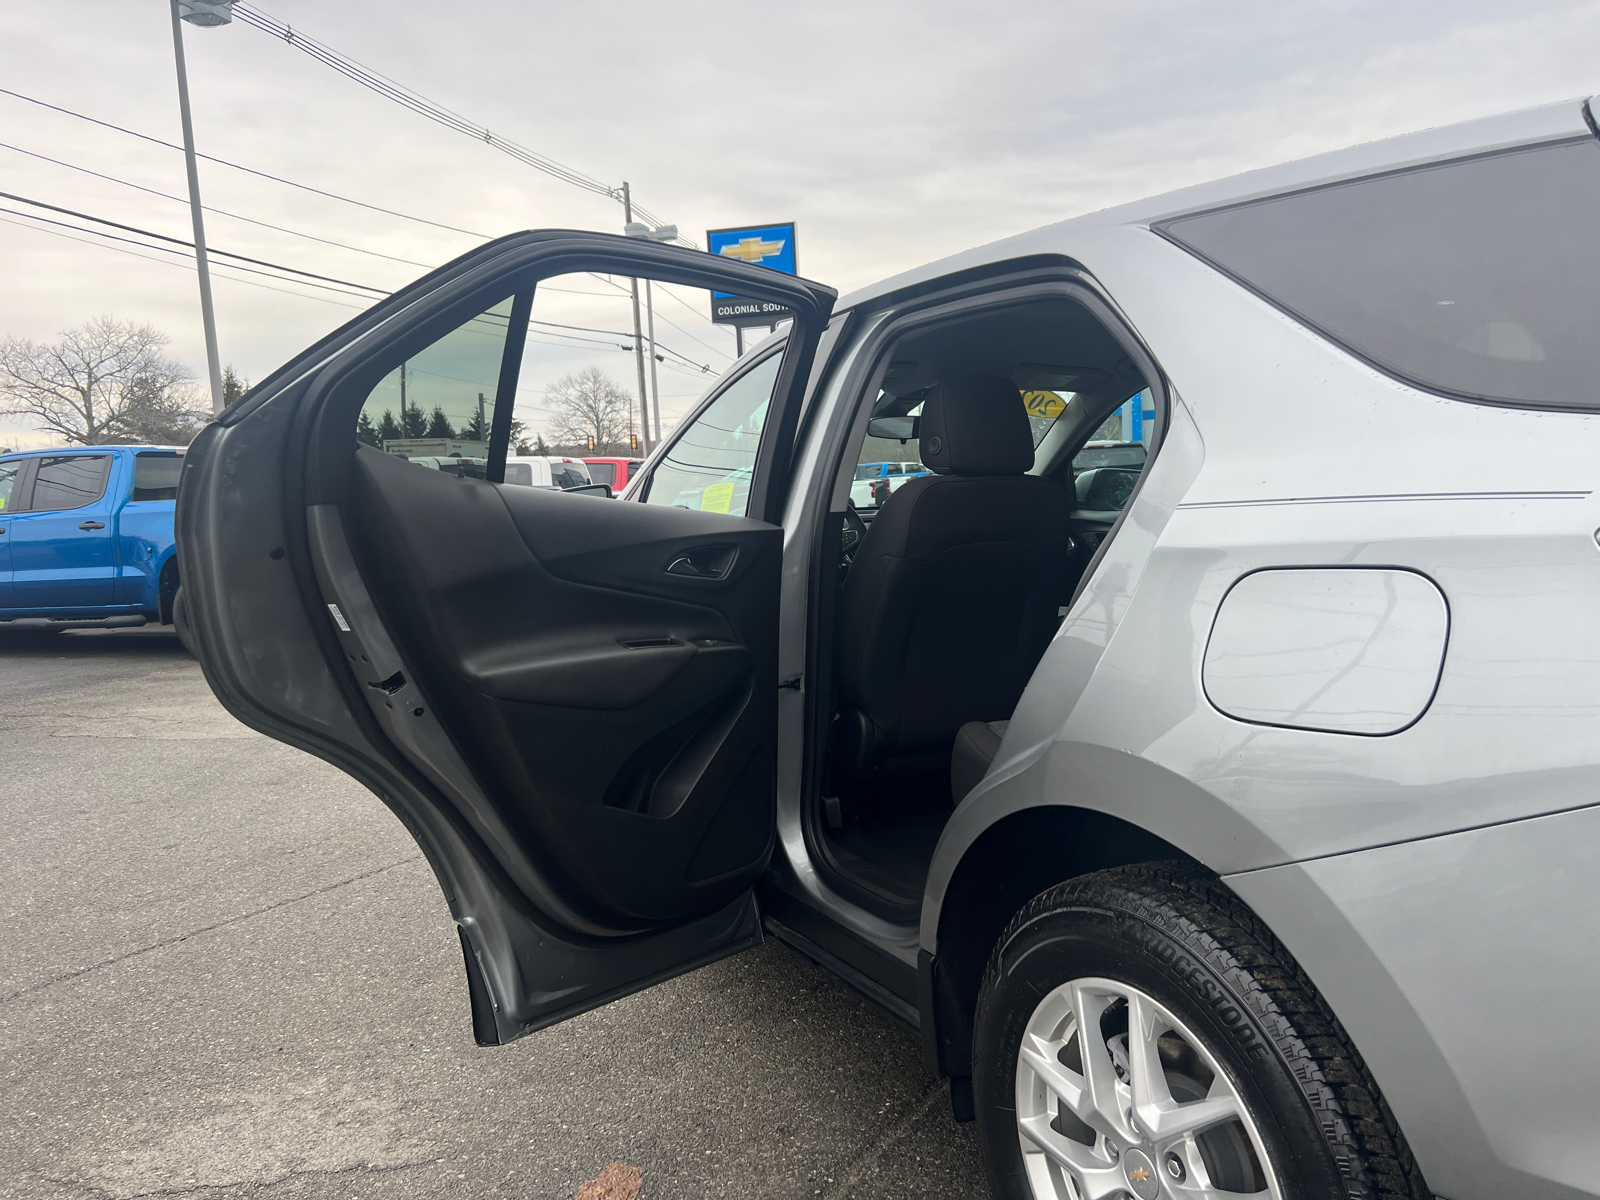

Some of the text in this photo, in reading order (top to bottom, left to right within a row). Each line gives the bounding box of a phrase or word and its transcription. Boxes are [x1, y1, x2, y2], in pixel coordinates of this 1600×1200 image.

[718, 303, 789, 315] COLONIAL SOU
[1120, 917, 1270, 1063] BRIDGESTONE
